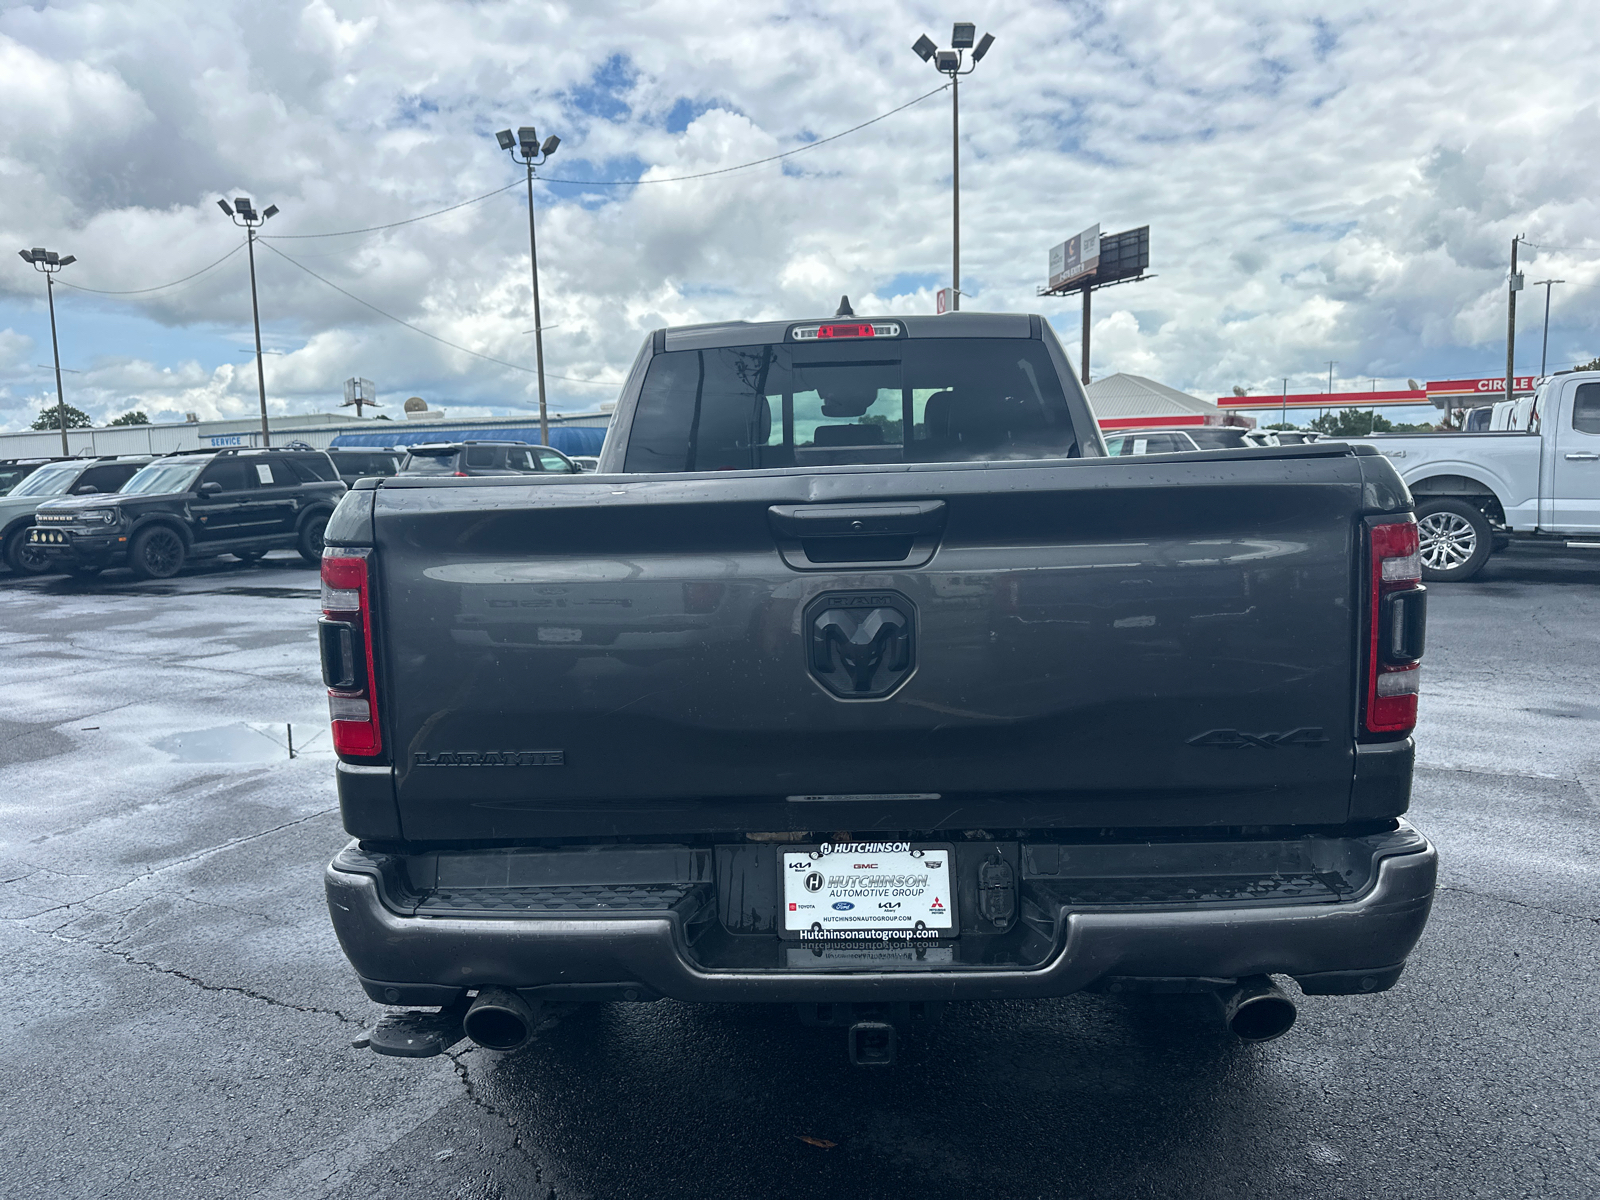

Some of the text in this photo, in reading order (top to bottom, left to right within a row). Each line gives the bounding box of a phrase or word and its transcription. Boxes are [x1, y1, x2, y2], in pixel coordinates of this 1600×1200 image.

[211, 437, 241, 447] SERVICE
[828, 595, 892, 606] RAM
[414, 749, 566, 767] LARAMIE
[834, 842, 911, 853] HUTCHINSON
[827, 875, 929, 888] HUTCHINSON
[829, 889, 925, 898] AUTOMOTIVE GROUP
[799, 930, 939, 941] Hutchinsonautogroup.com
